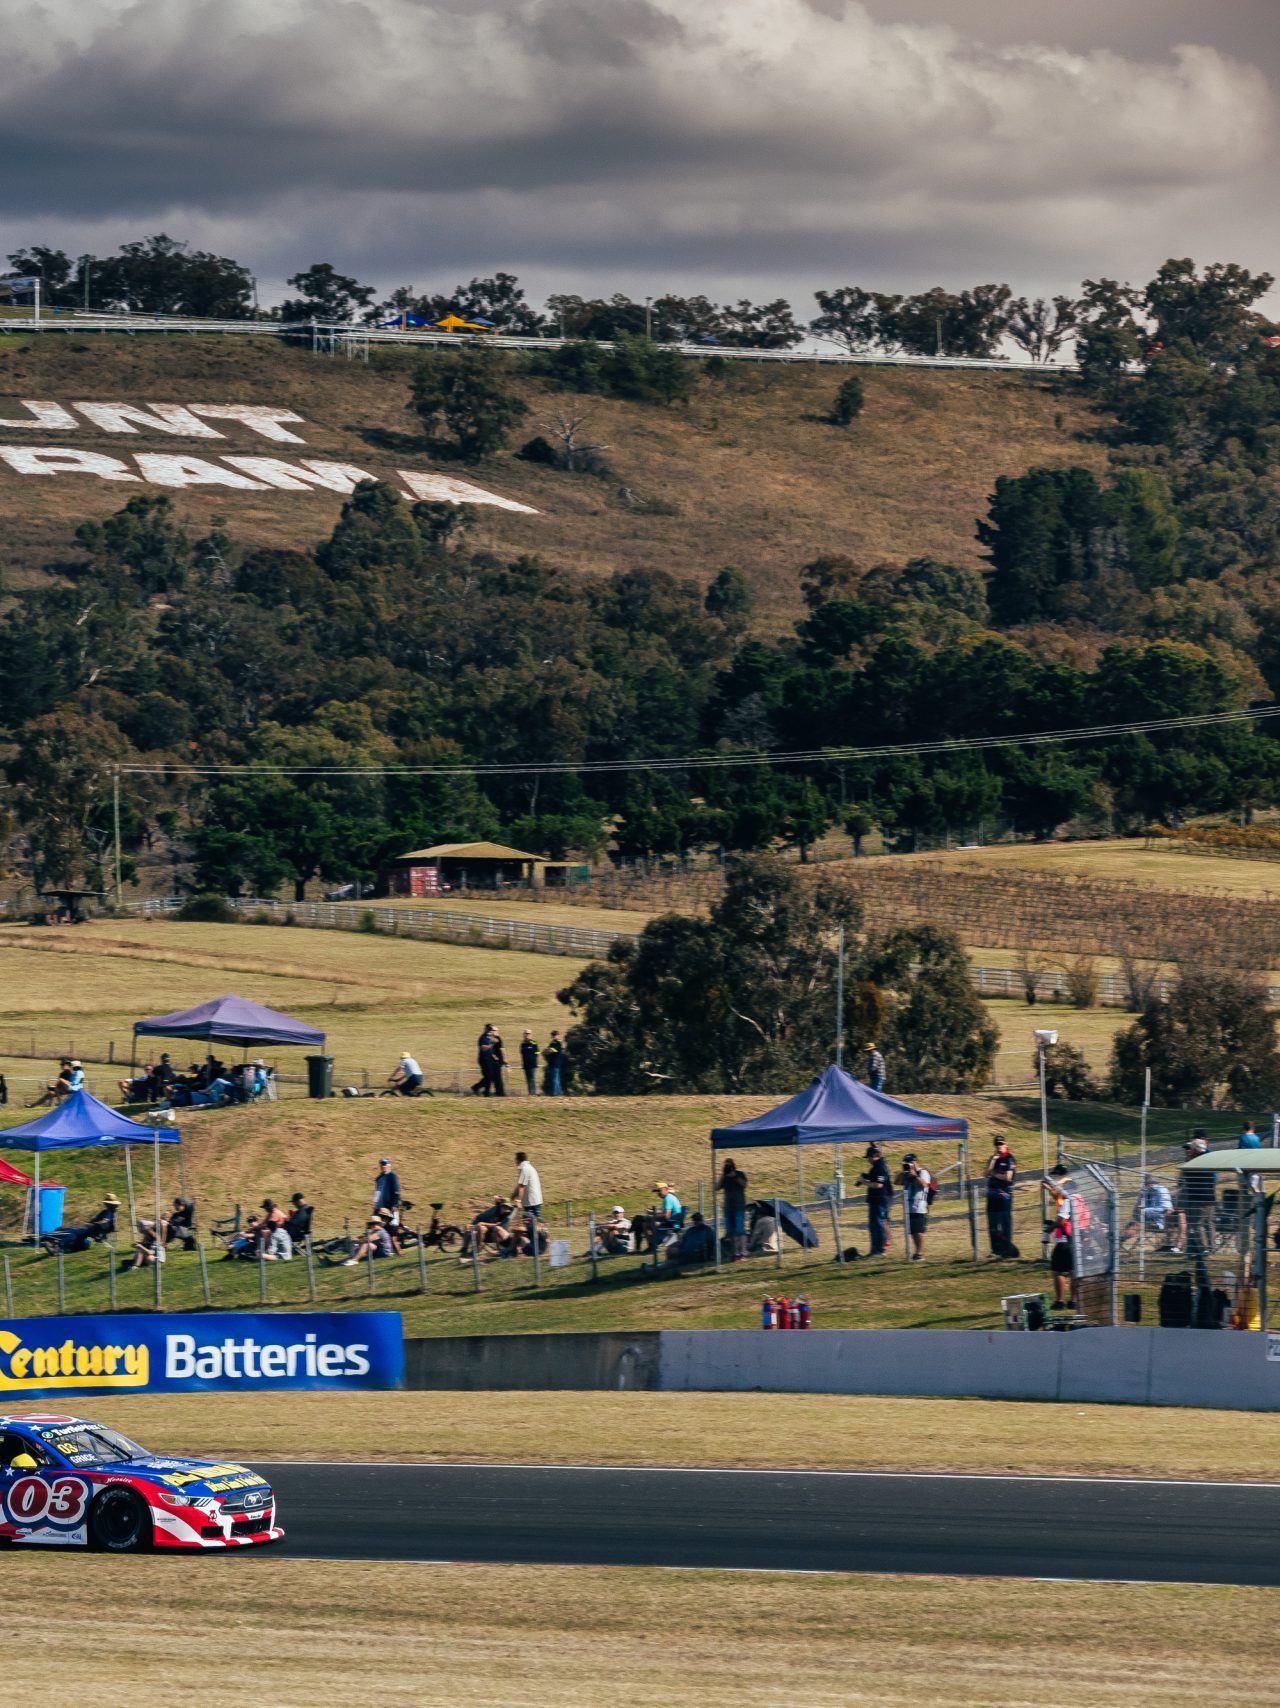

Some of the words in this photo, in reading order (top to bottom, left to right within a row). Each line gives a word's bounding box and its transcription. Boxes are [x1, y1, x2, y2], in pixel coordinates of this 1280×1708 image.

[166, 1333, 370, 1379] Batteries
[57, 1442, 79, 1454] 03
[70, 1454, 97, 1464] GRICE
[10, 1477, 85, 1519] 03
